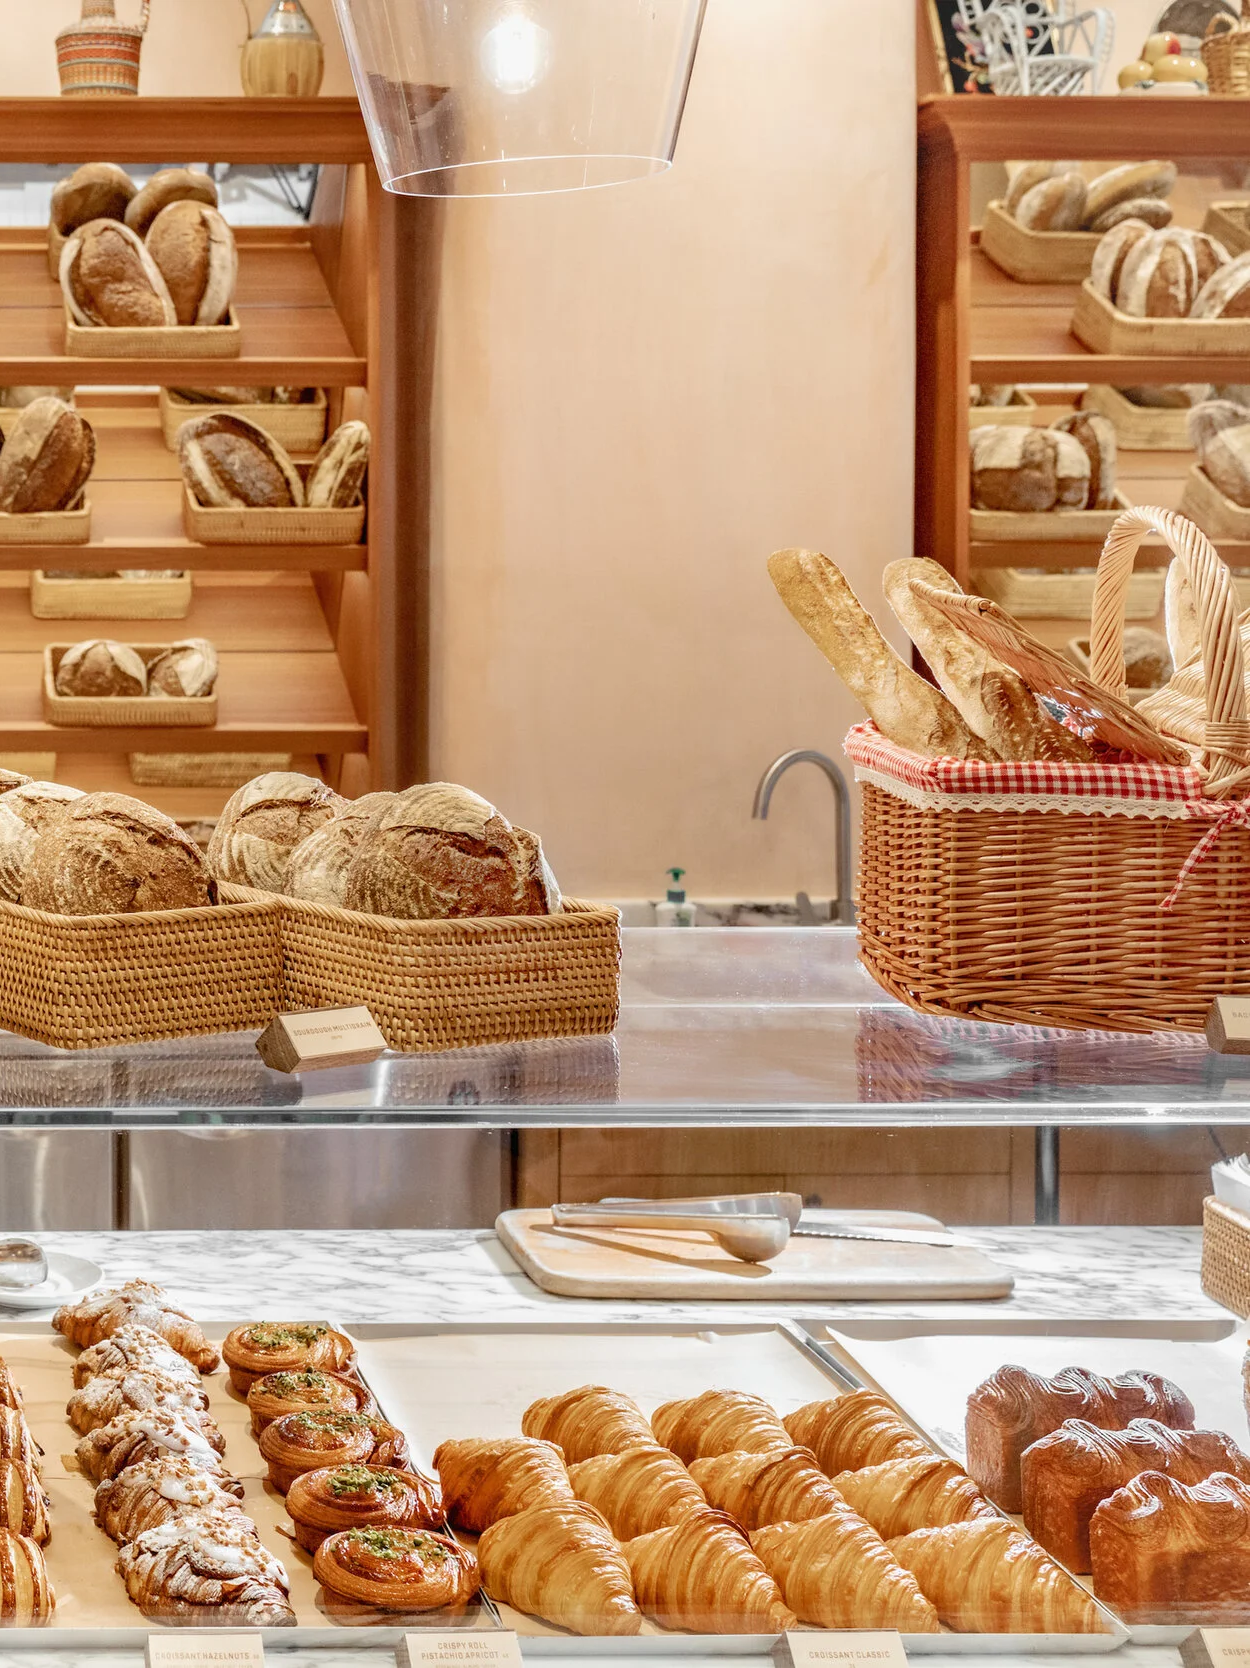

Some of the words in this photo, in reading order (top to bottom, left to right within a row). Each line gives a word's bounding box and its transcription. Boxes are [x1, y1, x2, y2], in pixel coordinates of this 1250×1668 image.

[293, 1025, 332, 1036] SOURDOUGH
[469, 1641, 488, 1649] ROLL
[155, 1652, 200, 1660] CROISSANT
[202, 1652, 249, 1660] HAZELNUTS
[421, 1652, 463, 1660] PISTACHIO
[809, 1650, 854, 1658] CROISSANT
[856, 1650, 891, 1658] CLASSIC
